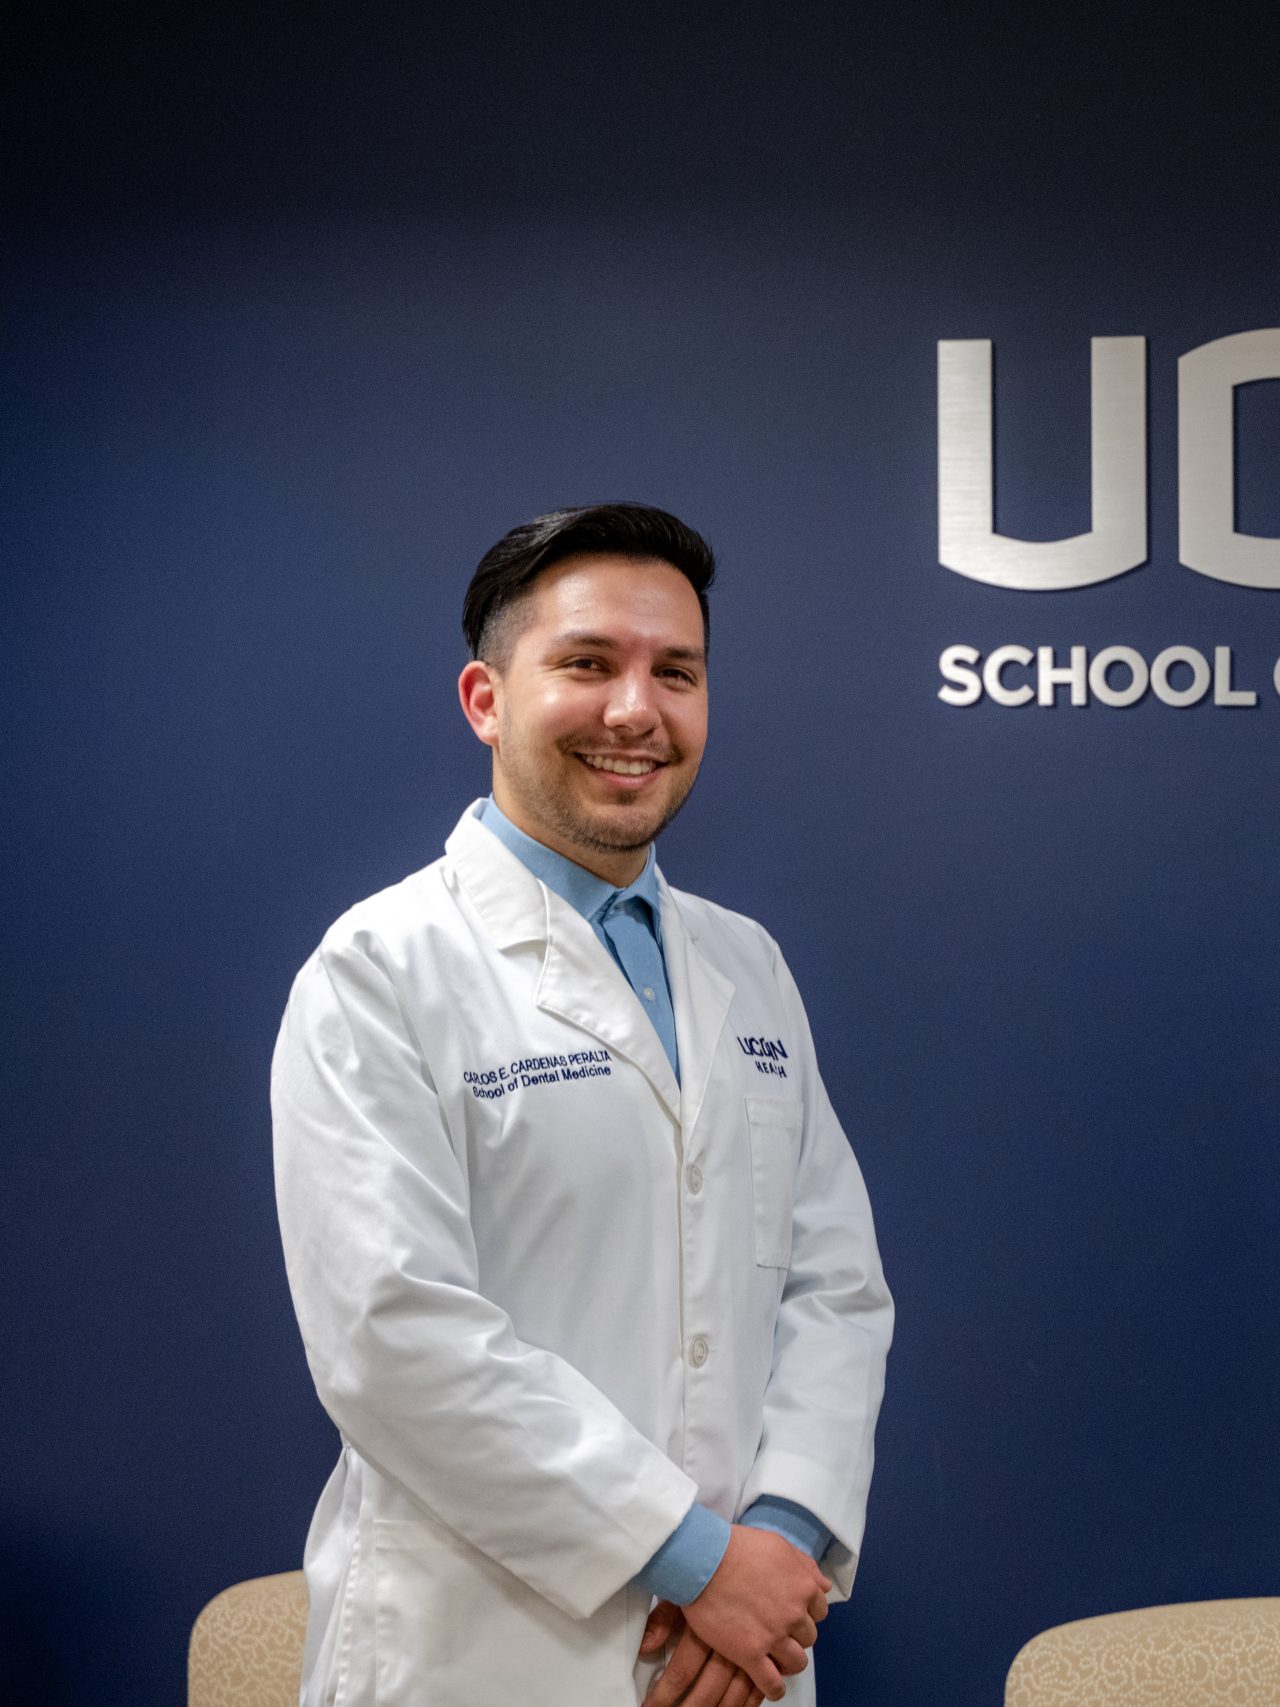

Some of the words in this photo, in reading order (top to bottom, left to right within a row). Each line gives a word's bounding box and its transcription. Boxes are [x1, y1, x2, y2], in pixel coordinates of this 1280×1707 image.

[937, 645, 1257, 707] SCHOOL
[736, 1036, 788, 1061] UCON
[463, 1069, 498, 1086] CARLOS
[510, 1054, 568, 1075] CARDENAS
[567, 1050, 612, 1065] PERALTA
[472, 1085, 505, 1099] School
[507, 1079, 519, 1092] of
[520, 1071, 560, 1087] Dental
[561, 1065, 611, 1080] Medicine
